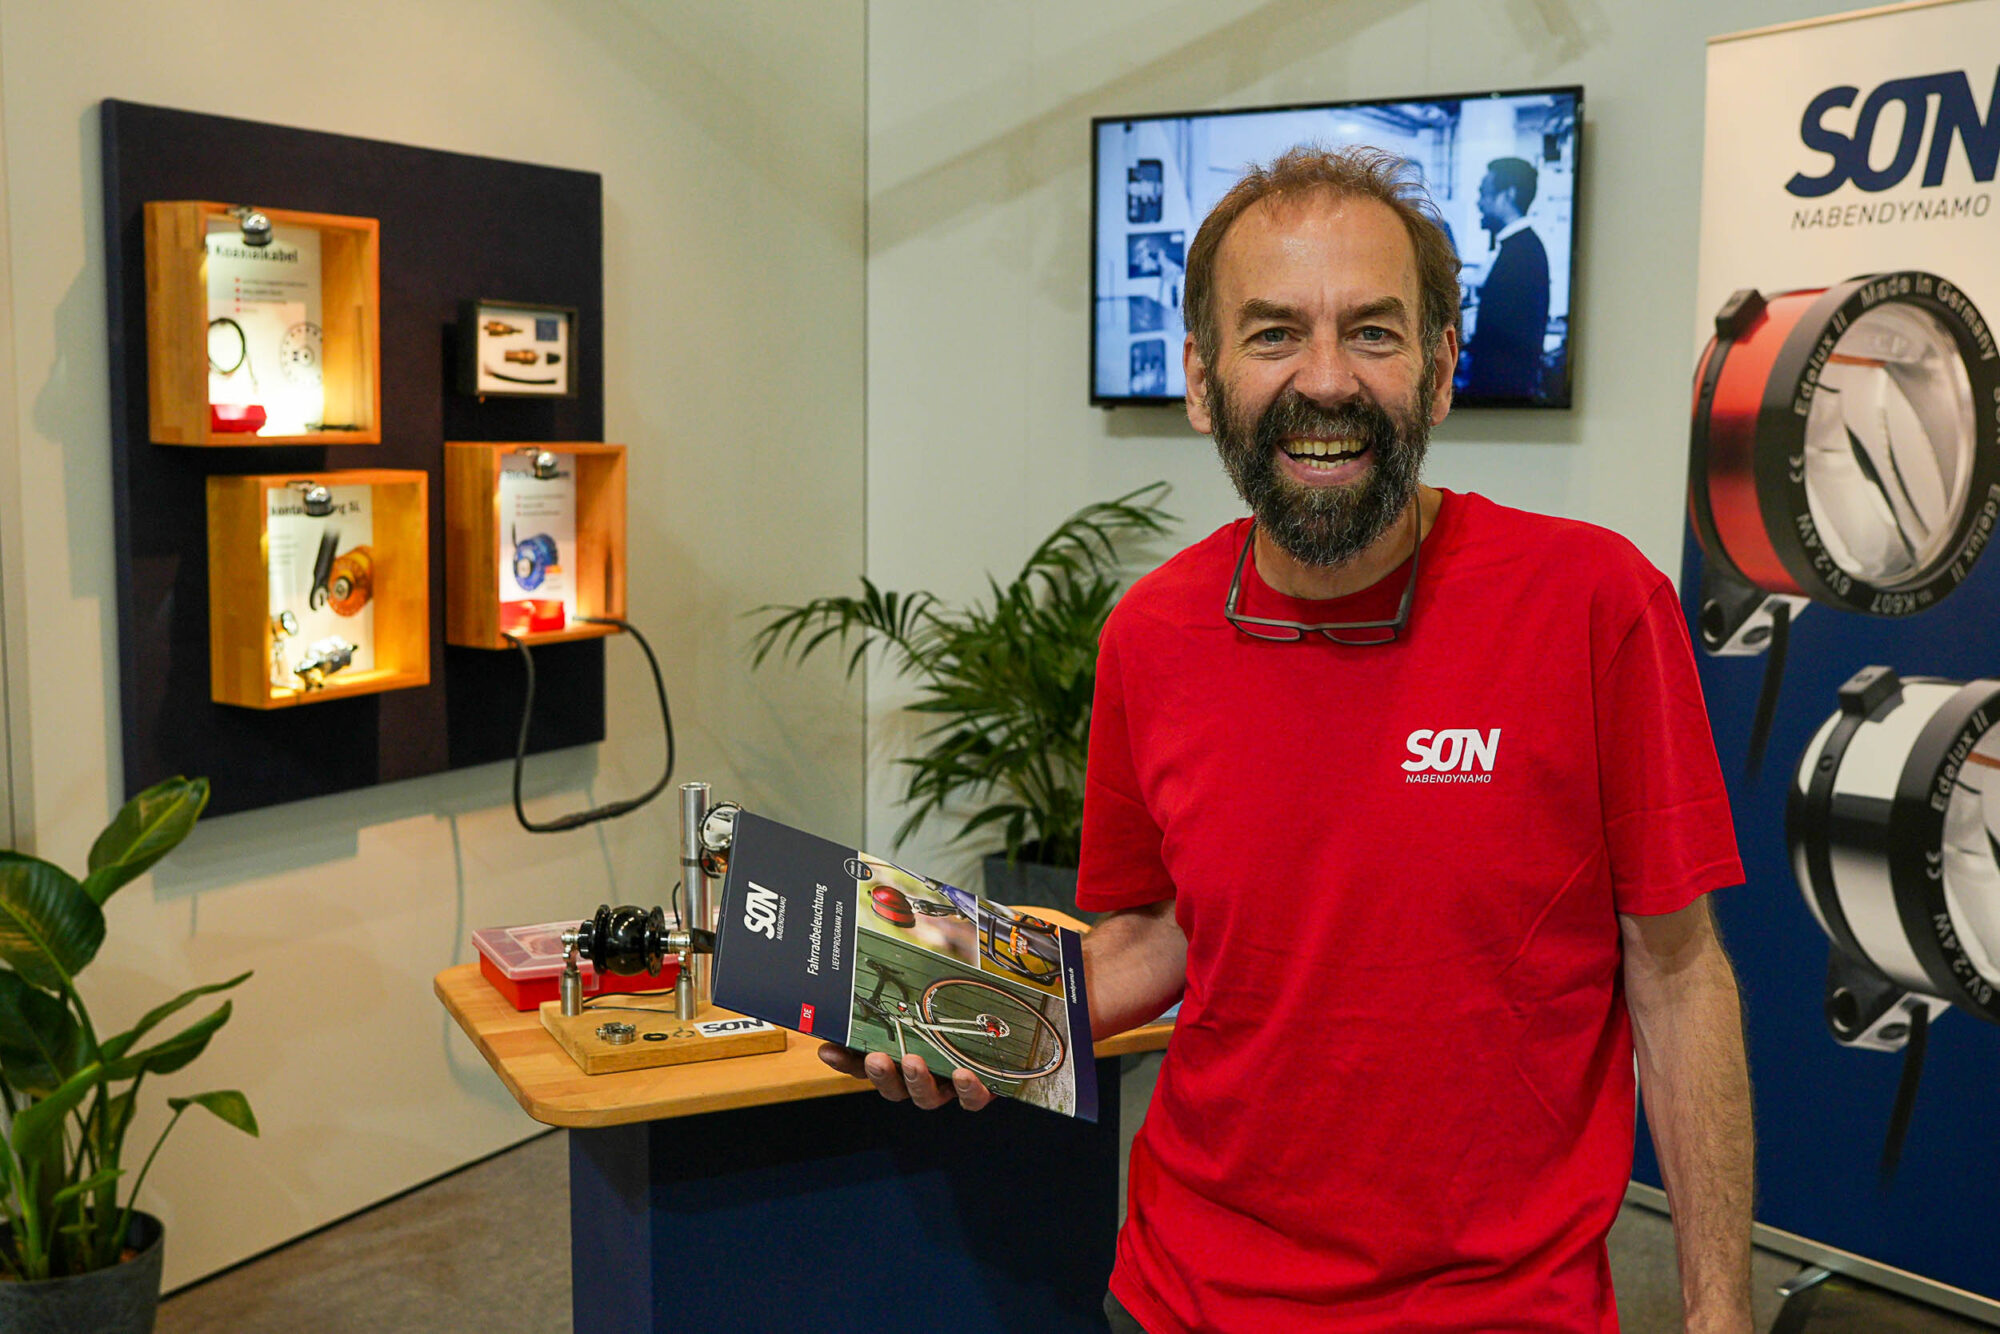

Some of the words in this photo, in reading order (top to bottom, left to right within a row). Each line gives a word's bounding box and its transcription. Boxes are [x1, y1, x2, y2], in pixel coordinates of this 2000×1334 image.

[1784, 64, 2000, 198] SON
[1791, 194, 1992, 230] NABENDYNAMO
[1860, 274, 1911, 309] Made
[1915, 272, 1932, 295] in
[1936, 279, 1998, 361] Germany
[1793, 334, 1834, 416] Edelux
[1400, 728, 1502, 772] SON
[1930, 731, 1975, 813] Edelux
[1405, 774, 1492, 784] NABENDYNAMO
[743, 880, 779, 940] SON
[776, 896, 787, 941] NABENDYNAMO
[806, 883, 828, 976] Fahrradbeleuchtung
[835, 900, 843, 915] 2024
[831, 915, 843, 971] LIEFERPROGRAMM
[703, 1019, 764, 1033] SON
[803, 1007, 812, 1019] DE
